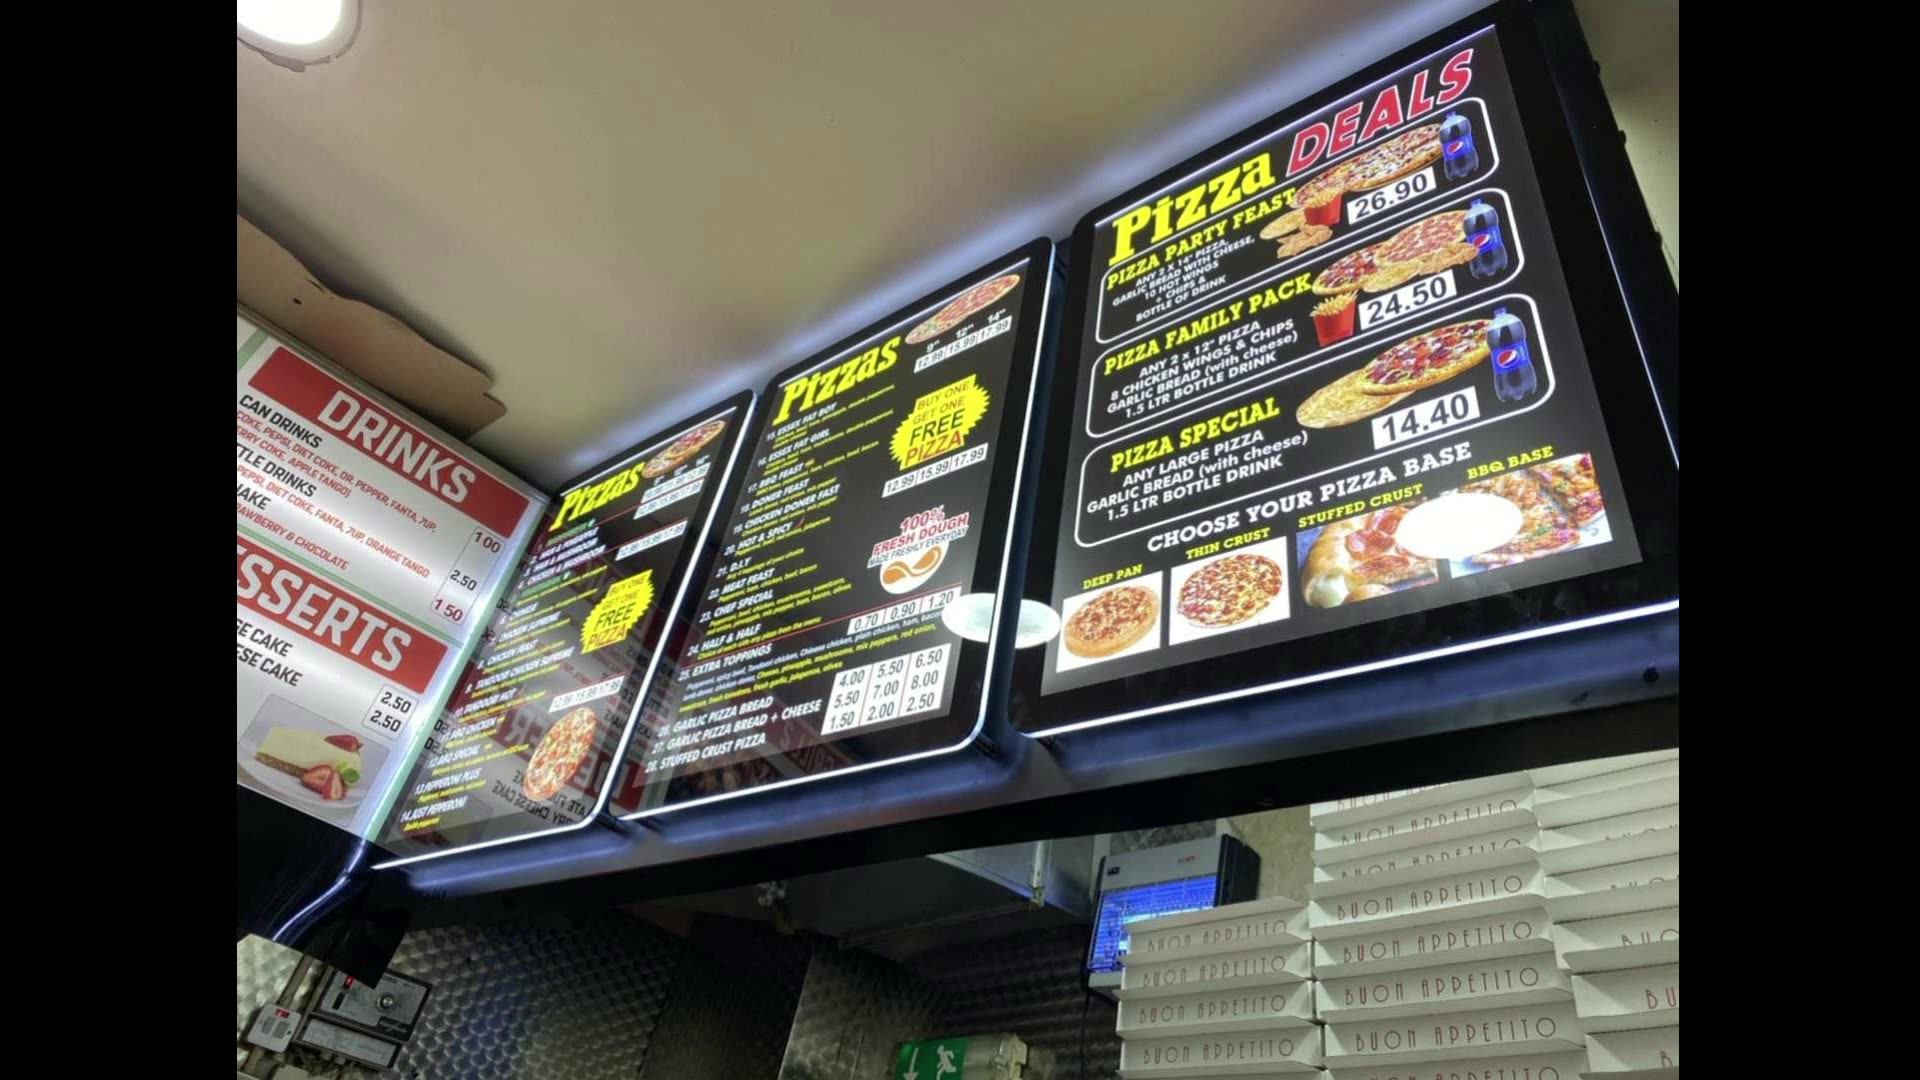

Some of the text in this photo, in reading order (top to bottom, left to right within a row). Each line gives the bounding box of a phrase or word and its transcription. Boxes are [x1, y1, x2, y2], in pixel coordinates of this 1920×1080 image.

[1109, 49, 1473, 265] Pizza DEALS
[1354, 172, 1429, 219] 26.90
[1107, 187, 1297, 290] PIZZA PARTY FEAST
[1112, 254, 1210, 306] GARLIC BREAD WITH
[1135, 271, 1156, 286] ANY
[1136, 274, 1225, 321] BOTTLE OF DRINK
[1144, 259, 1218, 299] 10 HOT WINGS
[1165, 279, 1195, 299] CHIPS
[1367, 275, 1448, 323] 24.50
[1104, 272, 1312, 375] PIZZA FAMILY PACK
[1110, 318, 1293, 401] 8 CHICKEN WINGS & CHIPS
[1139, 320, 1260, 378] ANY 2 PIZZA
[772, 336, 900, 425] Pizzas
[1107, 329, 1297, 413] GARLIC BREAD (with cheese)
[1125, 350, 1276, 418] 1.5 LTR BOTTLE DRINK
[912, 396, 965, 425] GET ONE
[916, 381, 969, 410] BUY ONE
[240, 394, 322, 449] CAN DRINKS
[801, 410, 817, 424] FAT
[909, 408, 965, 445] FREE
[1111, 396, 1279, 472] PIZZA SPECIAL
[1380, 392, 1470, 441] 14.40
[292, 444, 314, 460] DIET
[317, 390, 476, 503] DRINKS
[793, 436, 809, 450] FAT
[904, 428, 963, 465] PIZZA
[1123, 429, 1263, 487] ANY LARGE PIZZA
[263, 460, 316, 498] DRINKS
[288, 458, 318, 480] APPLE
[778, 462, 804, 479] FEAST
[886, 447, 984, 493] 12.99 15.99 17.99
[1086, 429, 1308, 513] GARLIC BREAD (with cheese)
[1466, 445, 1554, 480] BBQ BASE
[548, 462, 646, 532] Pizzas
[744, 507, 782, 529] CHICKEN
[783, 493, 816, 513] DONER
[817, 483, 840, 499] FAST
[750, 489, 782, 509] DONER
[783, 477, 809, 495] FEAST
[1107, 453, 1282, 521] 1.5 LTR BOTTLE DRINK
[1147, 441, 1472, 552] CHOOSE YOUR PIZZA BASE
[1298, 483, 1423, 528] STUFFED CRUST
[737, 534, 757, 549] HOT
[766, 521, 793, 539] SPICY
[873, 513, 967, 555] FRESH DOUGH
[900, 504, 946, 533] 100%
[295, 536, 349, 570] CHOCOLATE
[366, 537, 430, 578] ORANGE TANGO
[868, 526, 968, 566] MADE FRESHLY EVERYDAY
[1186, 527, 1270, 560] THIN CRUST
[450, 570, 477, 591] 2.50
[721, 577, 746, 594] MEAT
[746, 567, 774, 585] FEAST
[1082, 563, 1142, 590] DEEP PAN
[592, 601, 636, 631] FREE
[713, 588, 773, 617] CHEF SPECIAL
[853, 590, 953, 631] 0.70 0.90 1.20
[250, 628, 294, 657] CAKE
[584, 619, 632, 650] PIZZA
[700, 622, 761, 651] HALF HALF
[260, 658, 302, 687] CAKE
[691, 643, 772, 676] EXTRA TOPPINGS
[839, 649, 942, 687] 4.00 5.50 6.50
[380, 692, 412, 714] 2.50
[834, 670, 938, 708] 5.50 7.00 8.00
[370, 710, 402, 732] 2.50
[666, 699, 822, 749] GARLIC PIZZA BREAD CHEESE
[672, 695, 773, 732] GARLIC PIZZA BREAD
[829, 691, 934, 729] 1.50 2.00 2.50
[660, 732, 766, 768] STUFFED CRUST PIZZA
[1338, 876, 1522, 920] BUON APPETITO
[1344, 922, 1532, 963] BUON APPETITO
[1143, 968, 1187, 988] BUON
[1345, 967, 1539, 1006] BUON APPETITO
[1140, 995, 1286, 1024] BUON APPETITO
[1144, 1039, 1294, 1064] BUON APPETITO
[1356, 1017, 1556, 1051] BUON APPETITO
